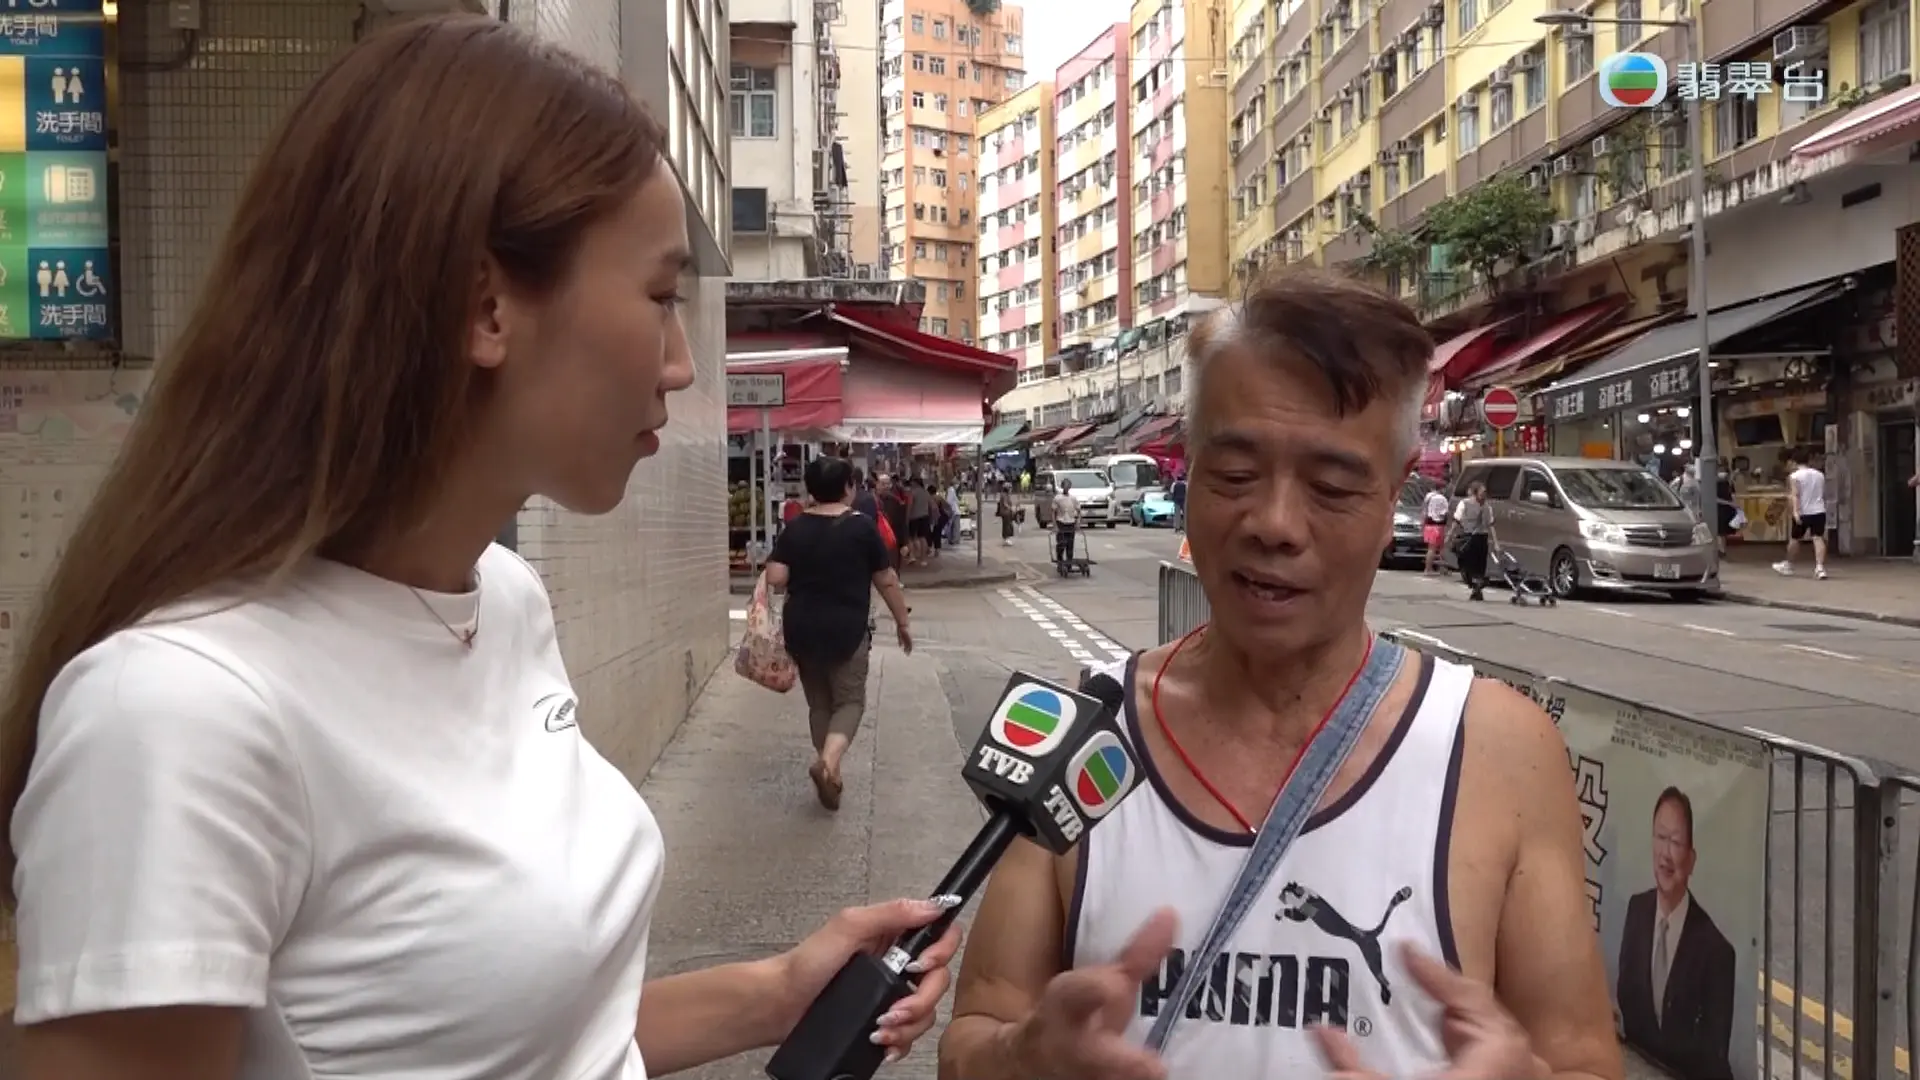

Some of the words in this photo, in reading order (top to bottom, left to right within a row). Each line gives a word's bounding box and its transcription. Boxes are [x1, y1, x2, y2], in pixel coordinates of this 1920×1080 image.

[36, 110, 102, 133] 洗手間
[40, 304, 106, 325] 洗手間
[977, 744, 1035, 784] TVB
[1043, 784, 1084, 841] TVB
